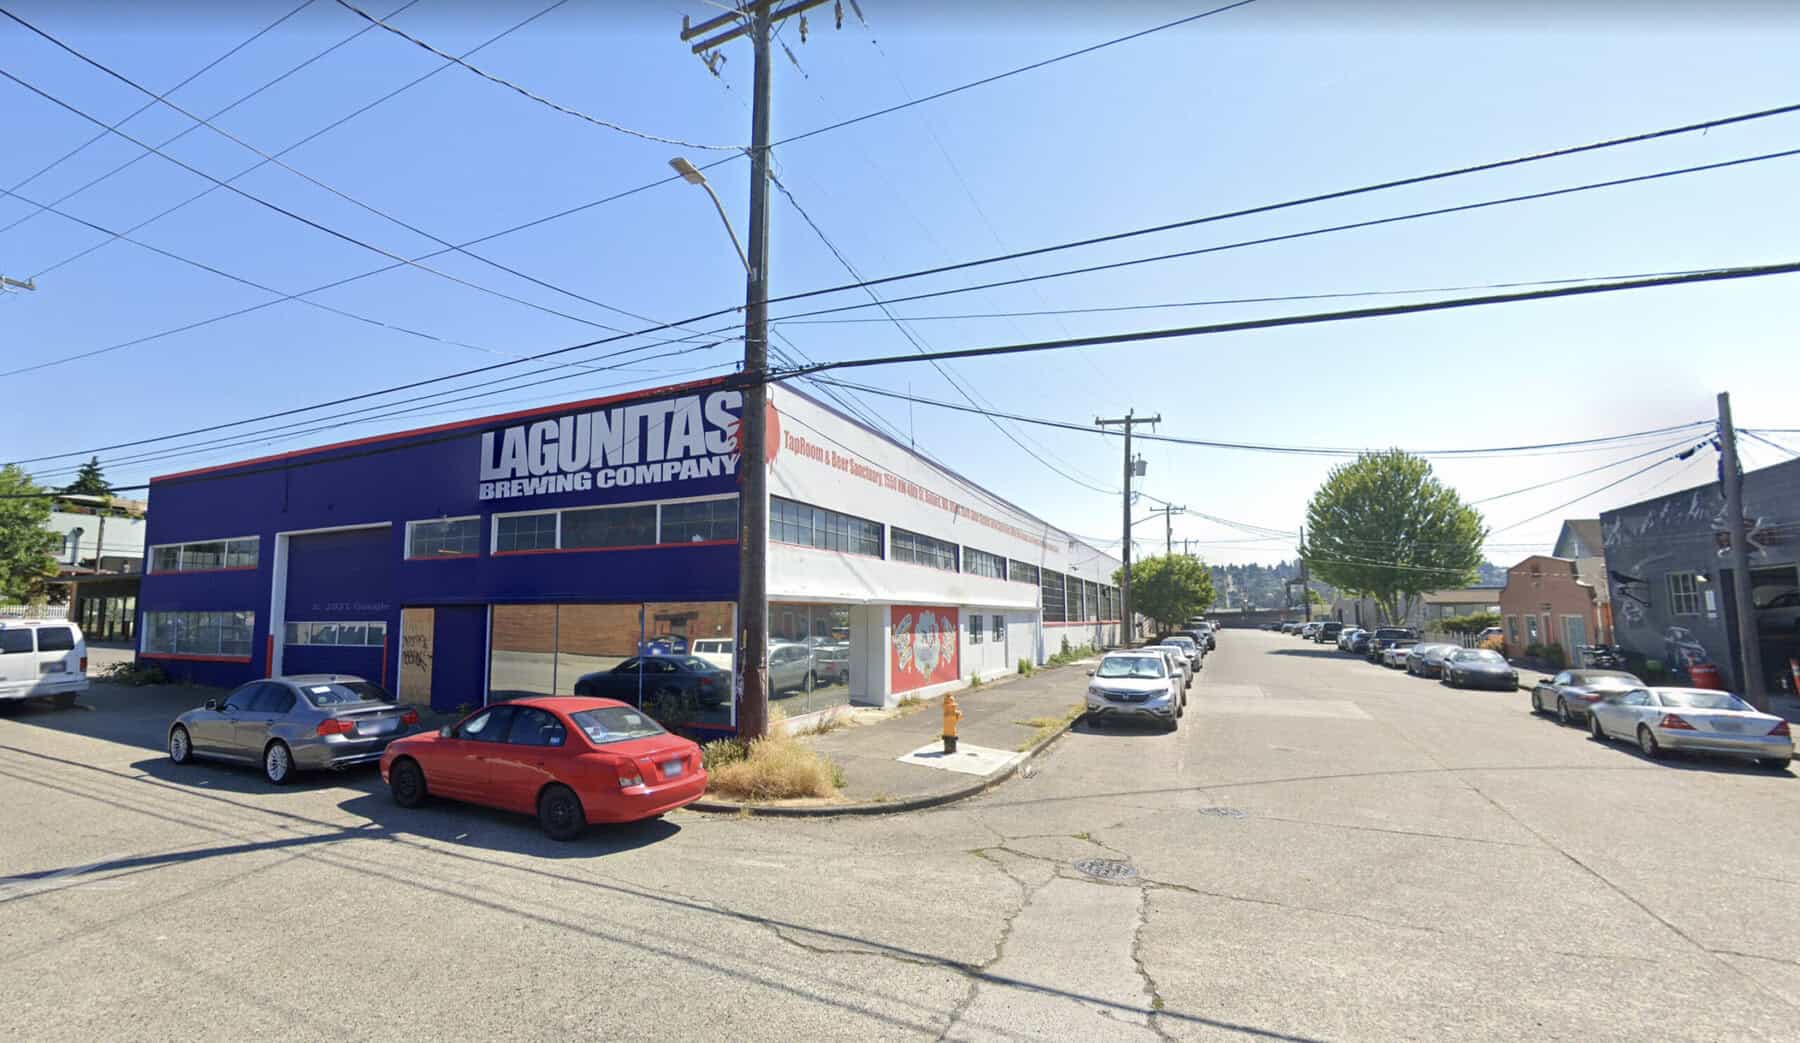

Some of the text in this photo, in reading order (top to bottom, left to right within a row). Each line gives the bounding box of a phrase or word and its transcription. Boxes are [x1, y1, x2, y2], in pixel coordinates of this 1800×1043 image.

[480, 391, 743, 481] LAGUNITAS
[784, 430, 824, 463] TapRoom
[479, 454, 740, 500] BREWING COMPANY
